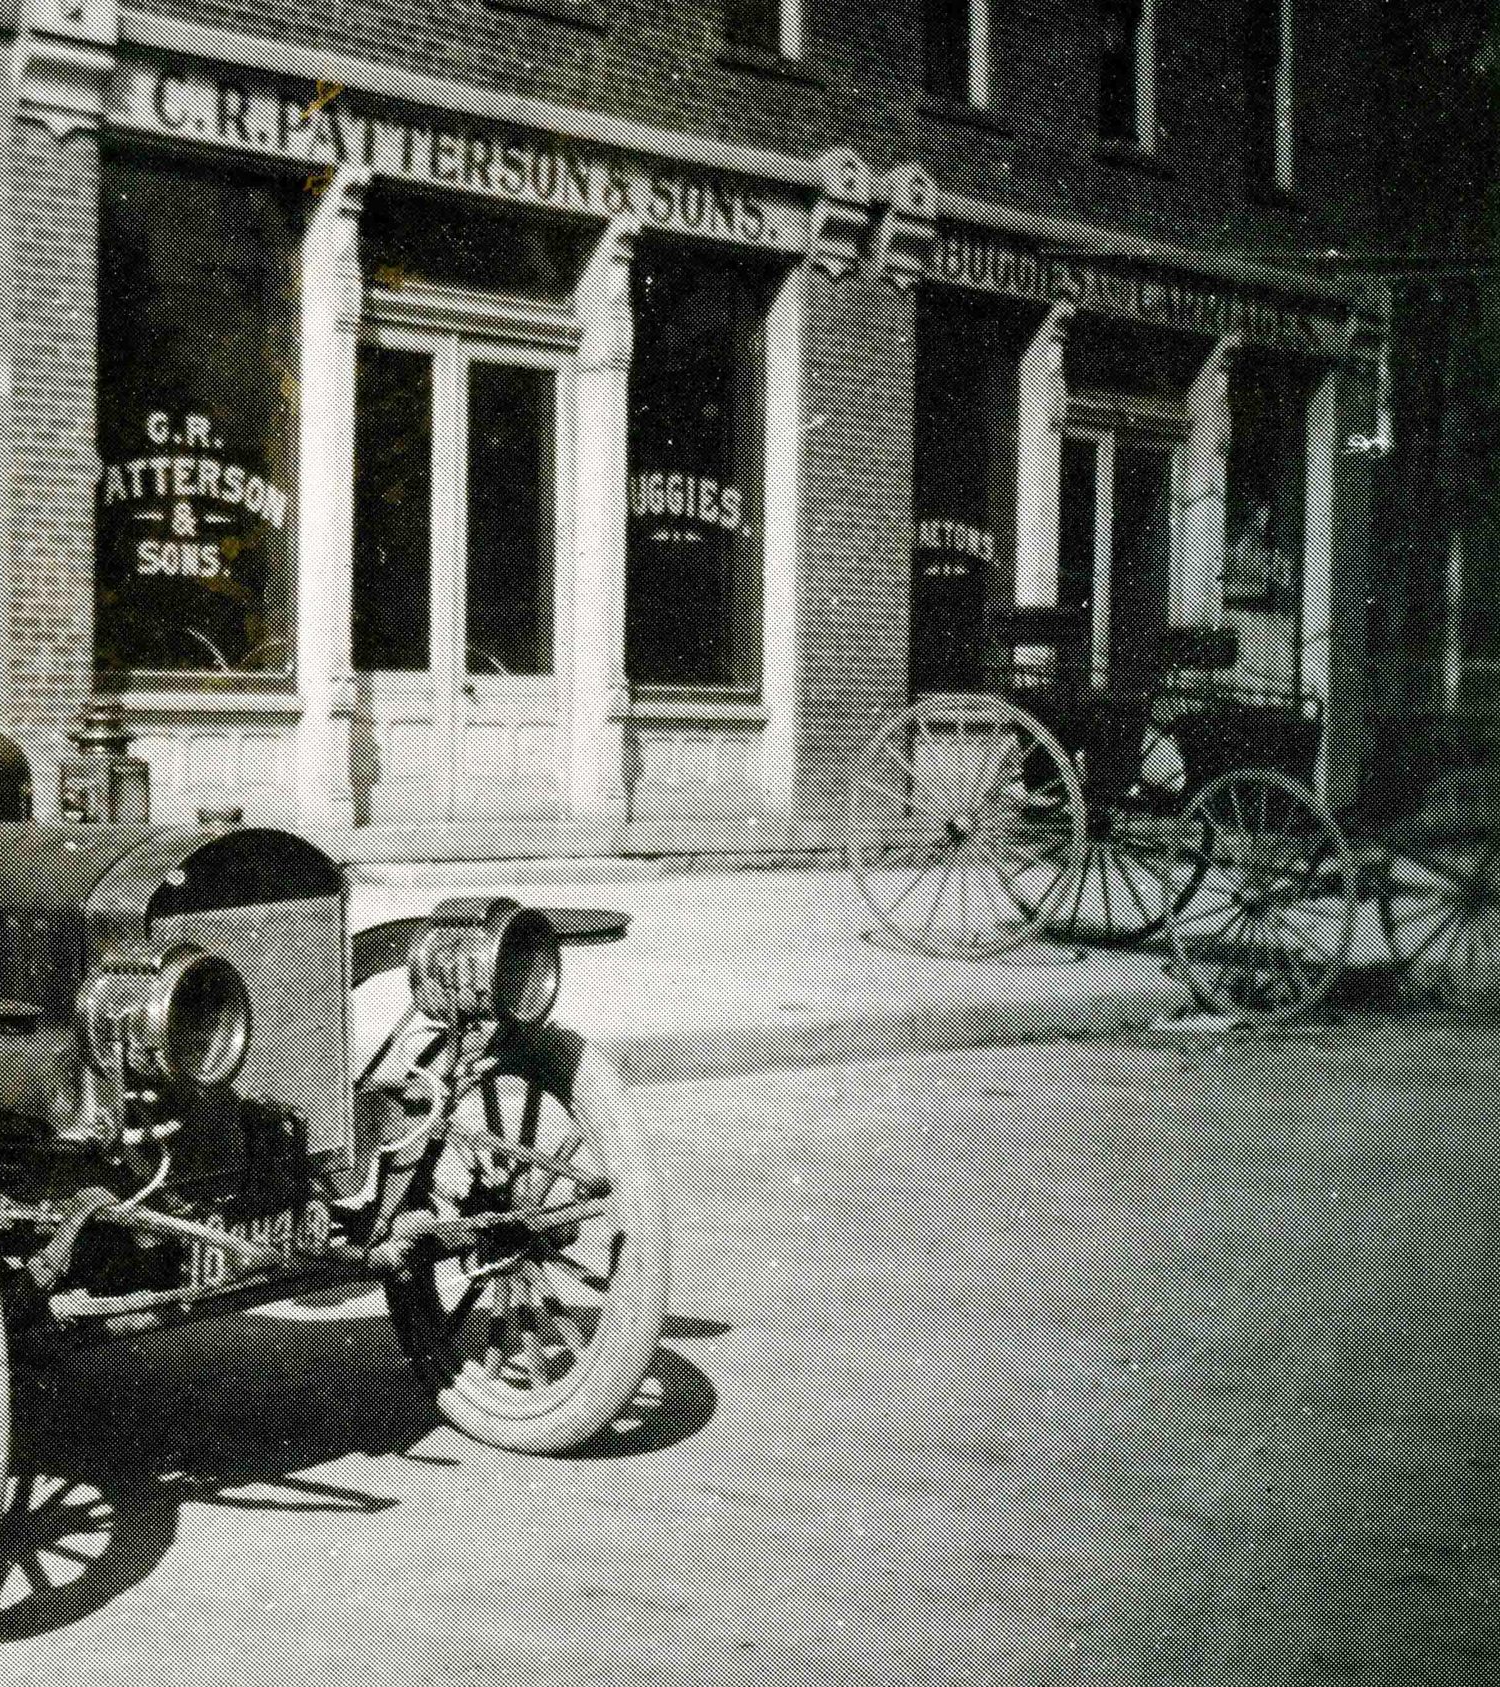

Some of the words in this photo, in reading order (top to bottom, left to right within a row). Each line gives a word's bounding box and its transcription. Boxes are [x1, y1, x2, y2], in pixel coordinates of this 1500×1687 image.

[276, 95, 590, 207] PATTERSON
[603, 163, 637, 216] &
[648, 176, 780, 242] SONS.
[137, 540, 231, 578] SONS.
